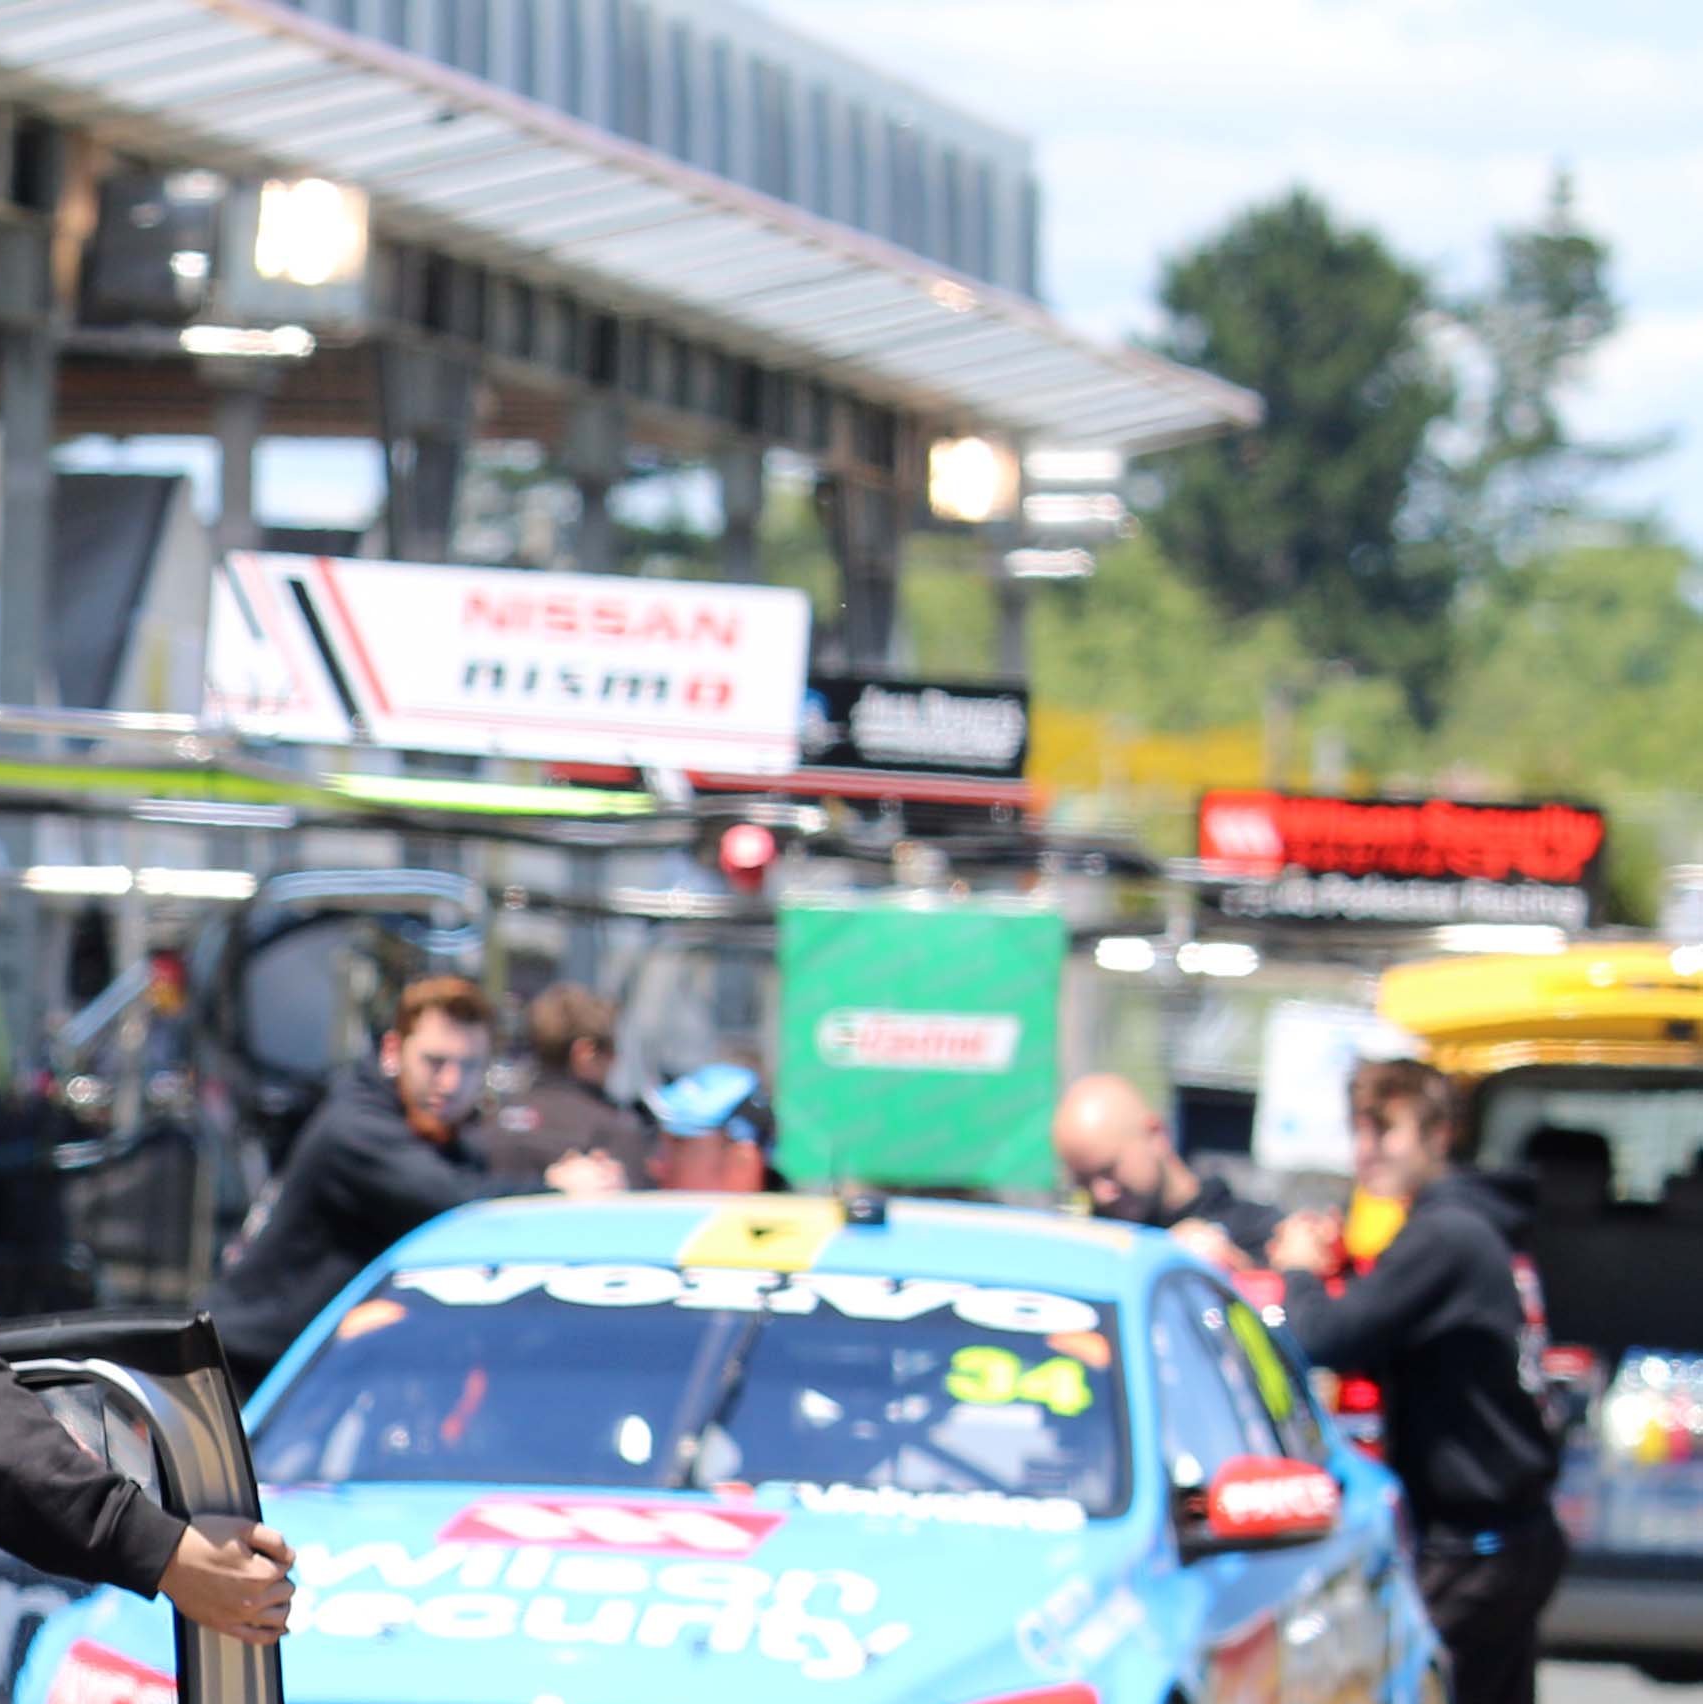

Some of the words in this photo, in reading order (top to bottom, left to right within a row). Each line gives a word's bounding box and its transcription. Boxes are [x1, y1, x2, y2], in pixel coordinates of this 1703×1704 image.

[459, 588, 743, 652] NISSAN
[393, 1263, 1099, 1336] VOLVO
[946, 1346, 1093, 1417] 34
